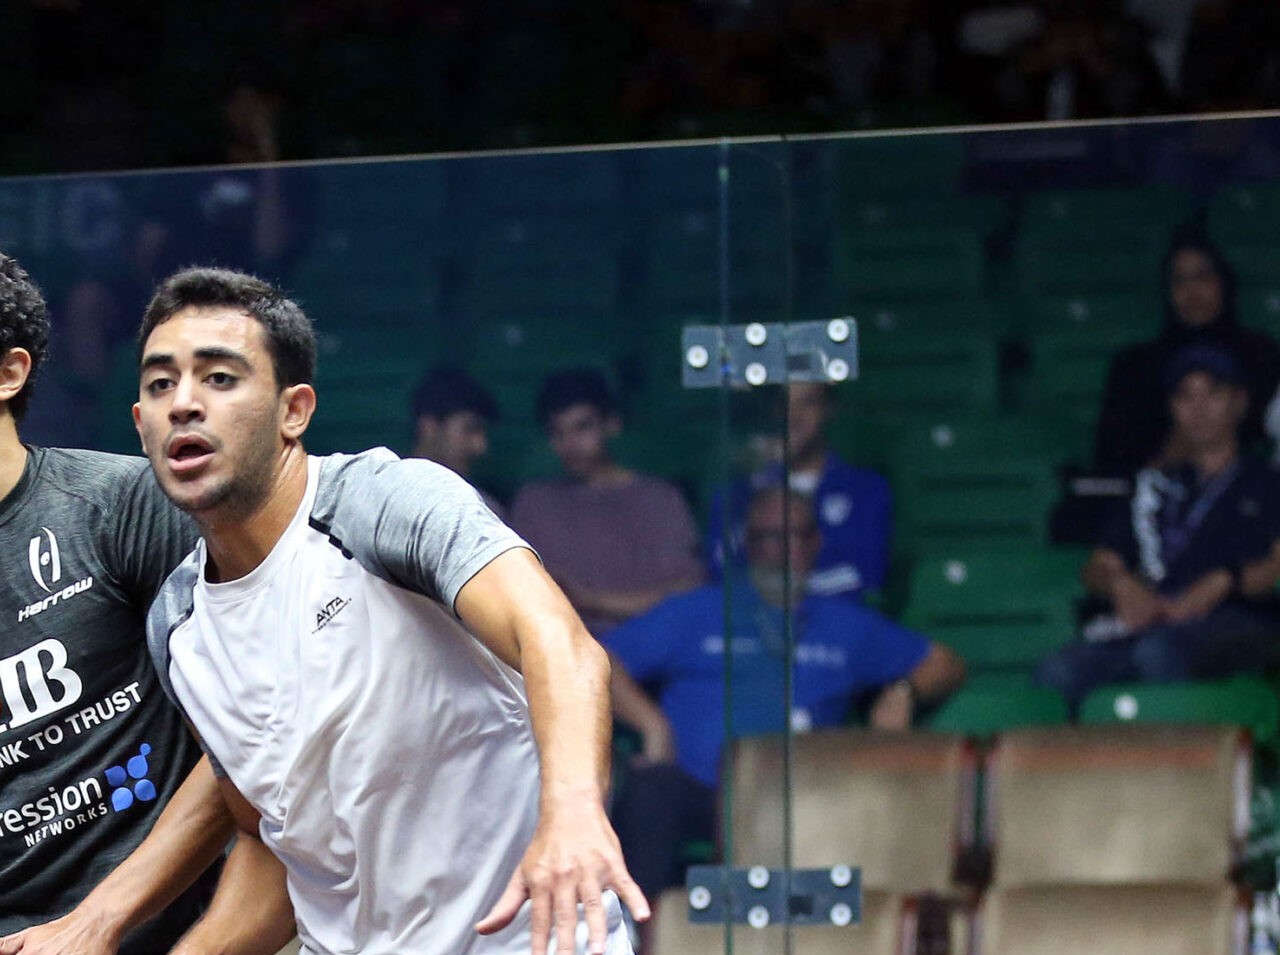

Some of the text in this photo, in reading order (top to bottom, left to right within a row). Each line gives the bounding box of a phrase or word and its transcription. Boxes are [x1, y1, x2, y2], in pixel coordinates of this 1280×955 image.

[316, 597, 344, 626] ANTA
[28, 724, 64, 751] TO
[65, 681, 142, 735] TRUST
[24, 802, 108, 847] NETWORKS
